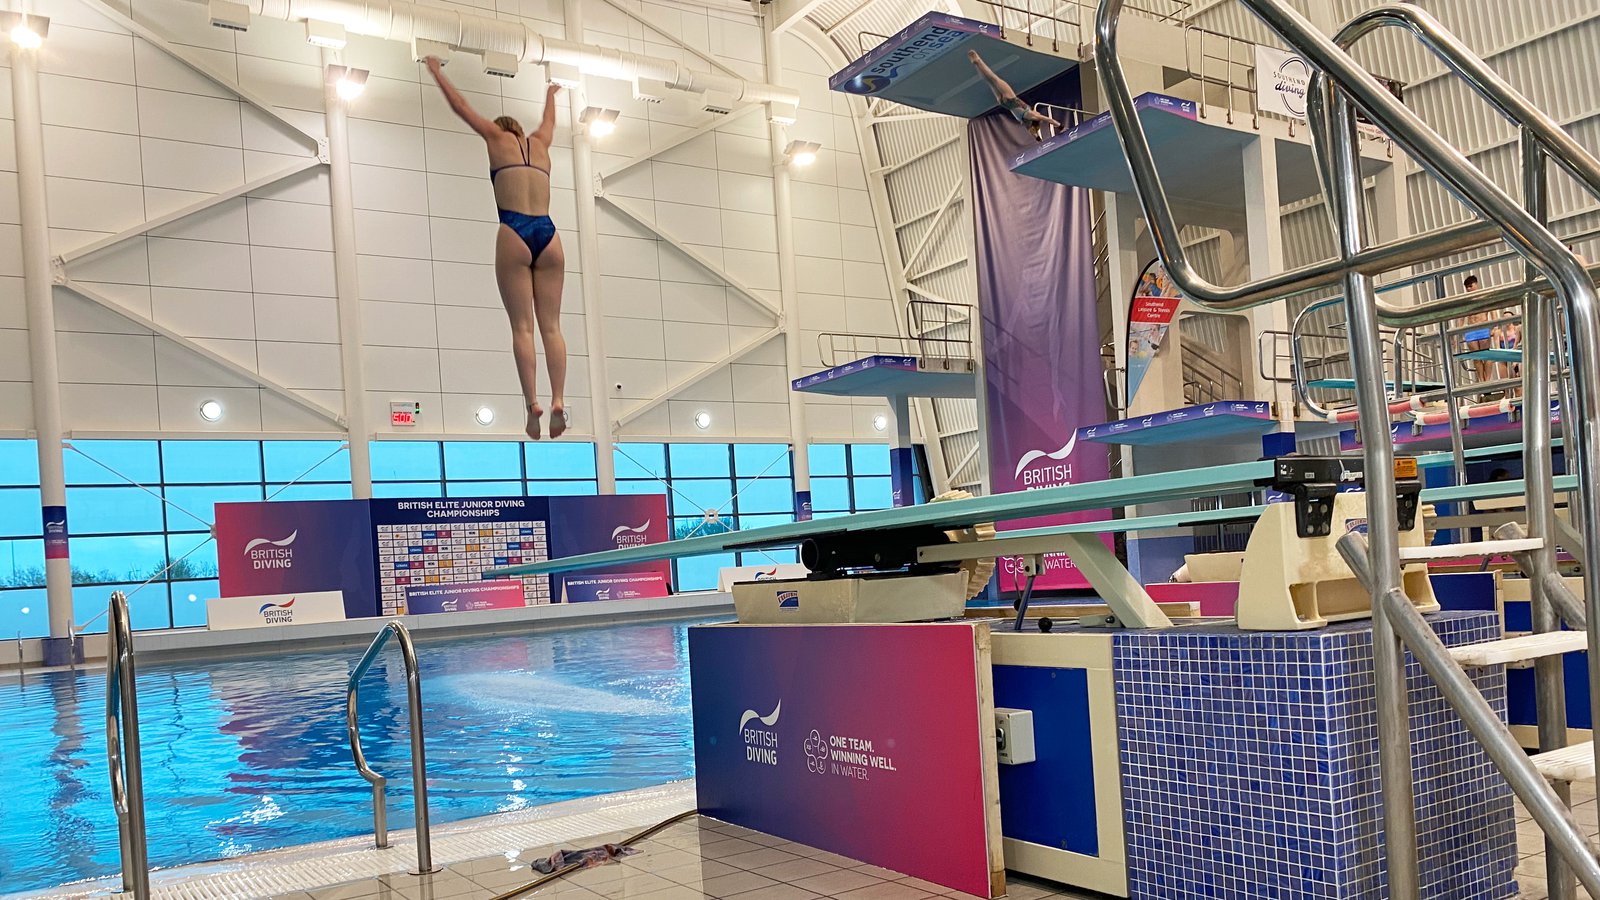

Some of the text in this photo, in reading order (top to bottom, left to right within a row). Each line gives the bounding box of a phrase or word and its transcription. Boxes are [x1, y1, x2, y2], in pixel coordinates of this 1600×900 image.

[871, 26, 950, 74] southend
[1275, 80, 1305, 99] diving
[1023, 463, 1072, 485] BRITISH
[397, 500, 525, 510] BRITISH ELITE JUNIOR DIVING
[426, 509, 500, 518] CHAMPIONSHIPS
[616, 534, 647, 544] BRITISH
[250, 548, 293, 559] BRITISH
[253, 559, 292, 569] DIVING
[263, 609, 293, 617] BRITISH
[265, 616, 293, 625] DIVING
[744, 728, 778, 748] BRITISH
[829, 735, 875, 753] ONE TEAM.
[746, 745, 777, 766] DIVING
[830, 748, 897, 772] WINNING WELL.
[831, 762, 870, 781] IN WATER.
